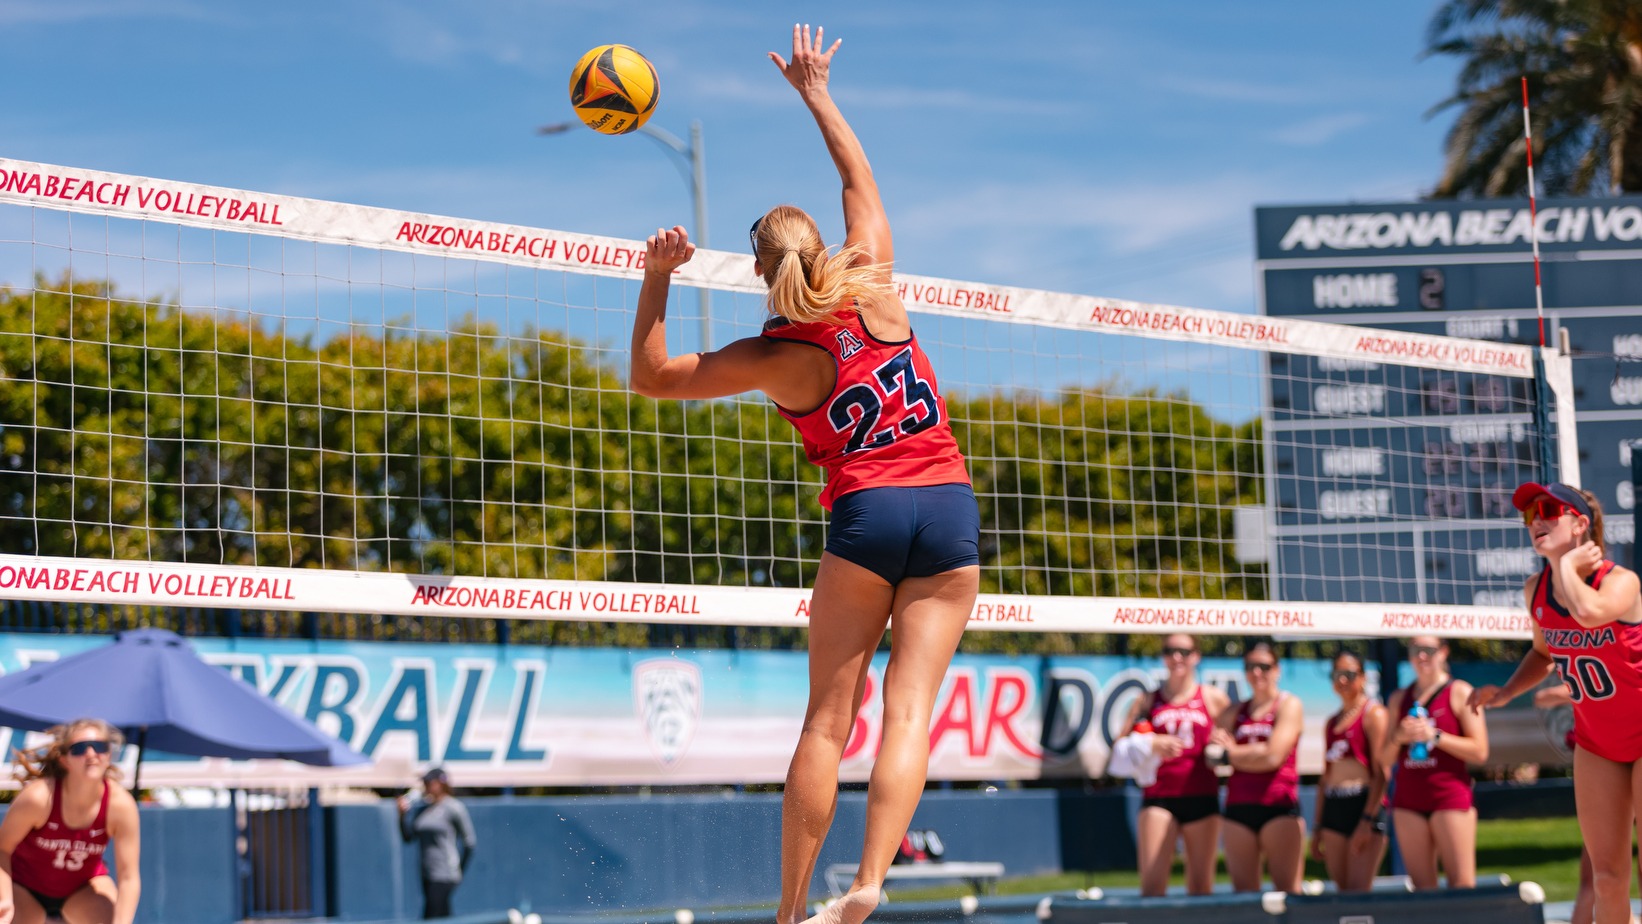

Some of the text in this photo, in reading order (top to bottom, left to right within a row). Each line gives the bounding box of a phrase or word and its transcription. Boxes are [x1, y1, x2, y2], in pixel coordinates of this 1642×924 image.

[138, 187, 283, 226] VOLLEYBALL
[1279, 212, 1454, 250] ARIZONA
[1455, 206, 1590, 245] BEACH
[563, 240, 680, 274] VOLLEYB
[913, 285, 1012, 313] VOLLEYBALL
[1313, 273, 1398, 309] HOME
[1420, 268, 1444, 309] 2
[1206, 319, 1289, 344] VOLLEYBALL
[1454, 346, 1527, 369] VOLLEYBALL
[826, 345, 941, 457] 23
[148, 573, 296, 600] VOLLEYBALL
[579, 592, 700, 614] VOLLEYBALL
[968, 604, 1034, 622] EYBALL
[1230, 609, 1314, 628] VOLLEYBALL
[1478, 614, 1532, 631] VOLLEYB
[1541, 627, 1616, 649] RIZONA
[1550, 653, 1616, 703] 30
[52, 850, 89, 871] 13
